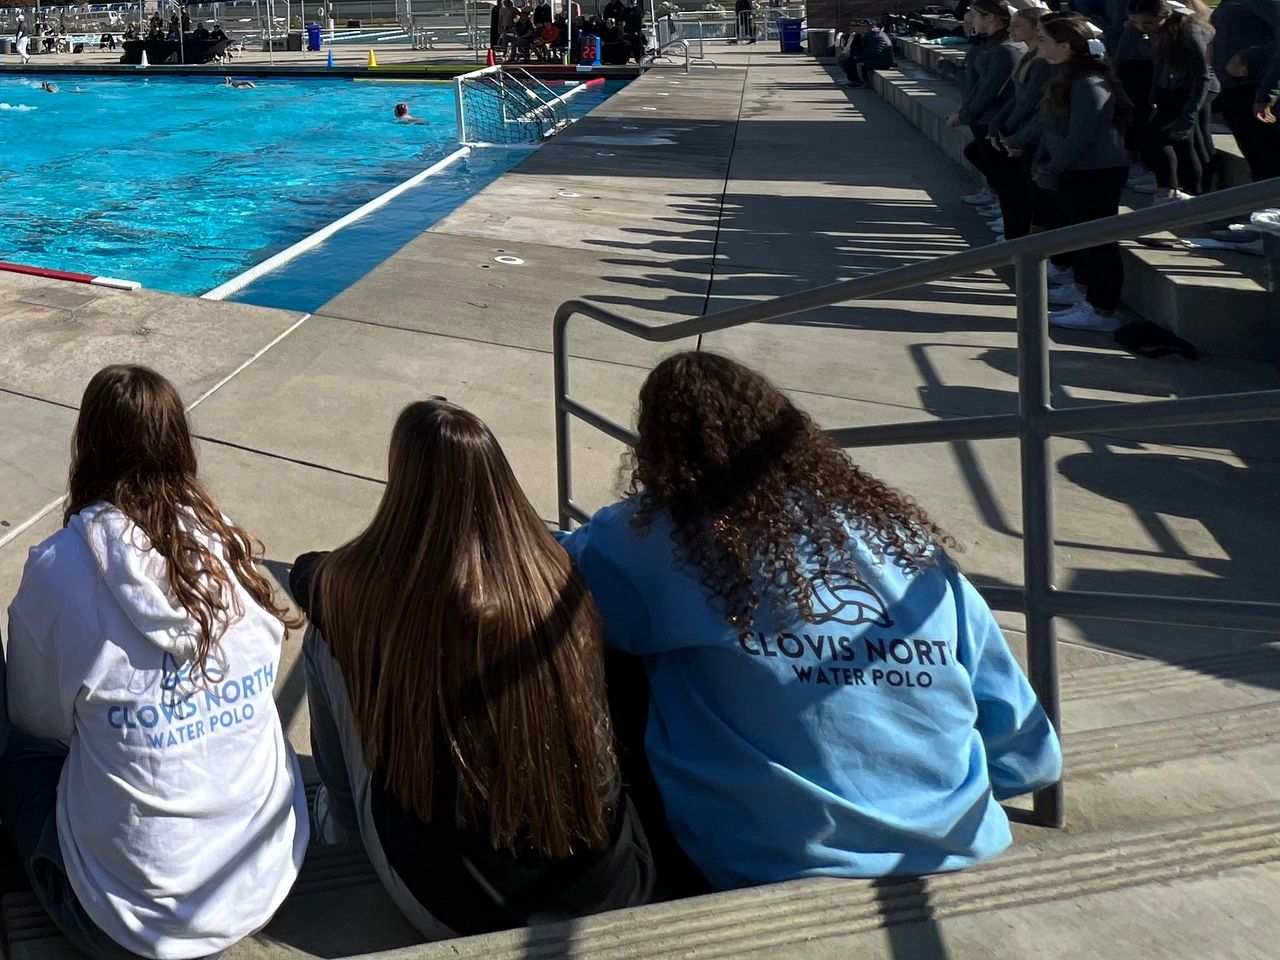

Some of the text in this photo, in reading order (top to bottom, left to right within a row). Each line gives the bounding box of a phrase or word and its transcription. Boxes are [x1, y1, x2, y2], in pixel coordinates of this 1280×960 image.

[583, 46, 595, 59] 22
[739, 631, 855, 662] CLOVIS
[792, 664, 933, 688] WATER POLO
[107, 661, 274, 729] CLOVIS NORTH
[147, 703, 255, 749] WATER POLO
